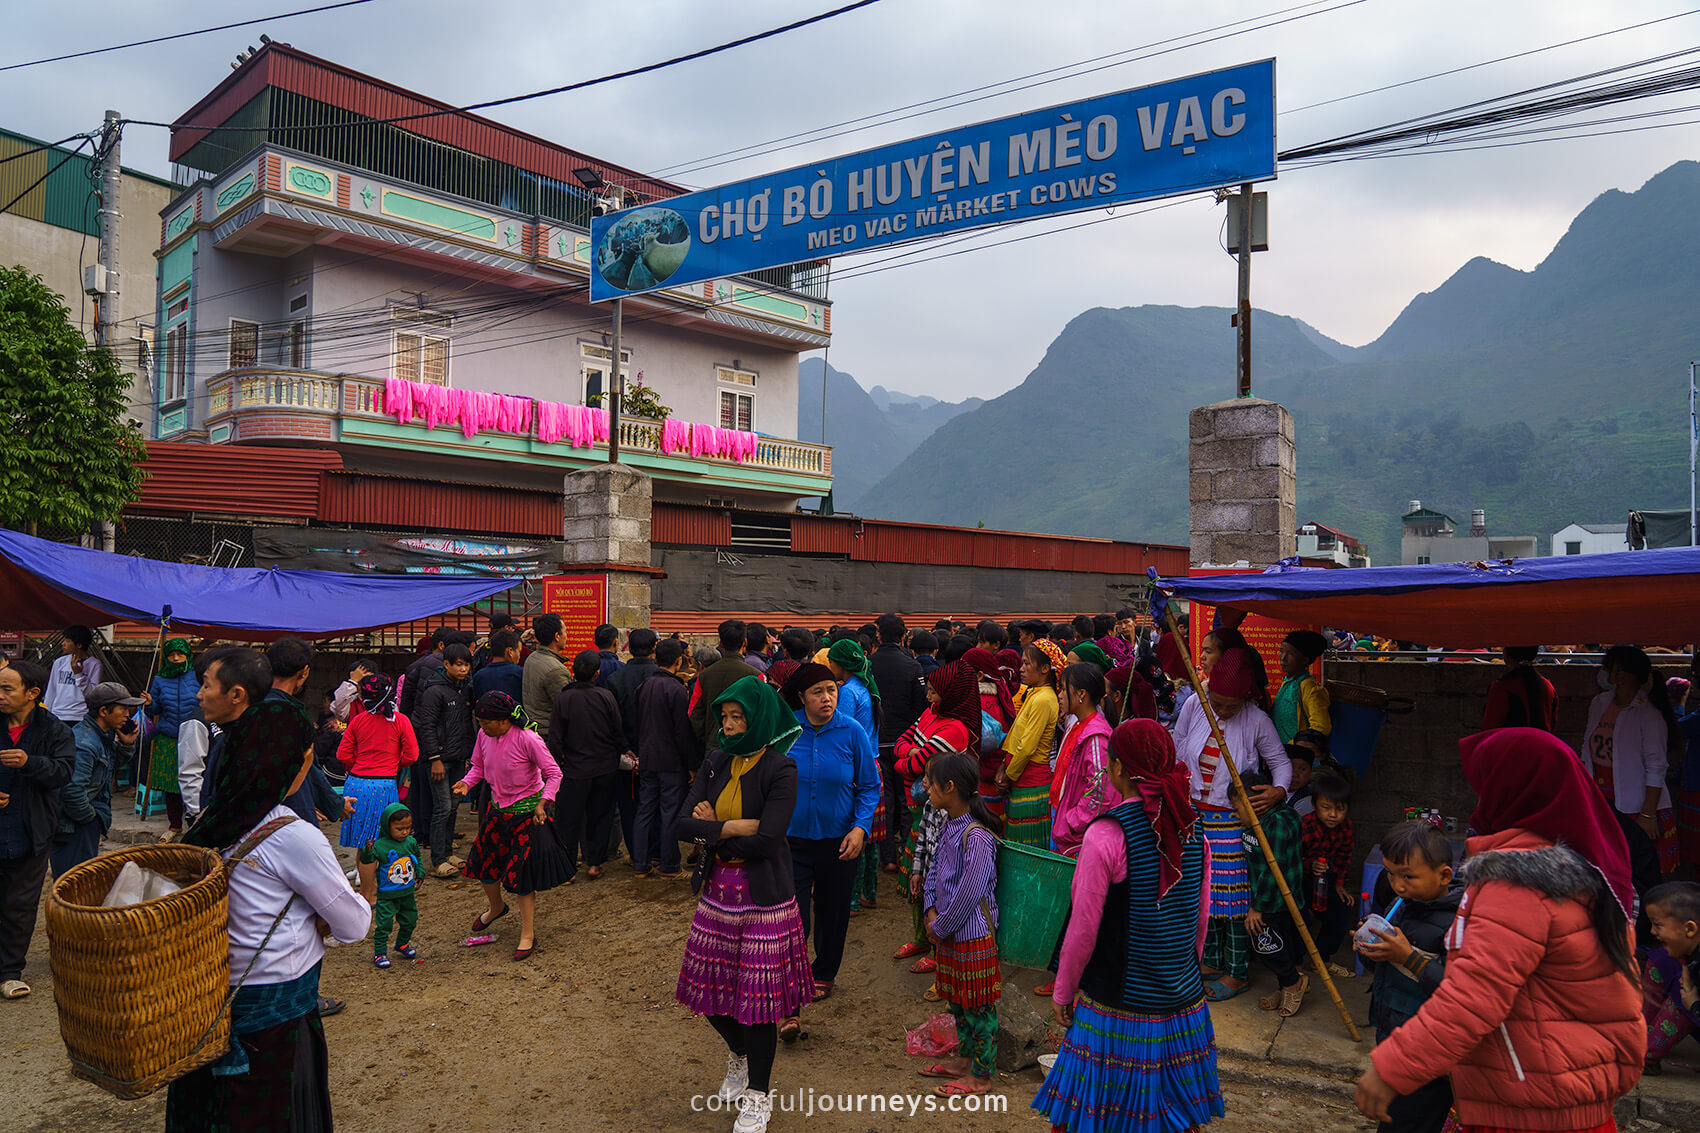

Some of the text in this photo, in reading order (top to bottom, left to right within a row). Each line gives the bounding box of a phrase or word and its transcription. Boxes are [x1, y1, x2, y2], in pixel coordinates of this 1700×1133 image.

[699, 87, 1247, 244] CHỢ BÒ HUYỆN MÈO VẠC
[808, 172, 1118, 250] MEO VAC MARKET COWS
